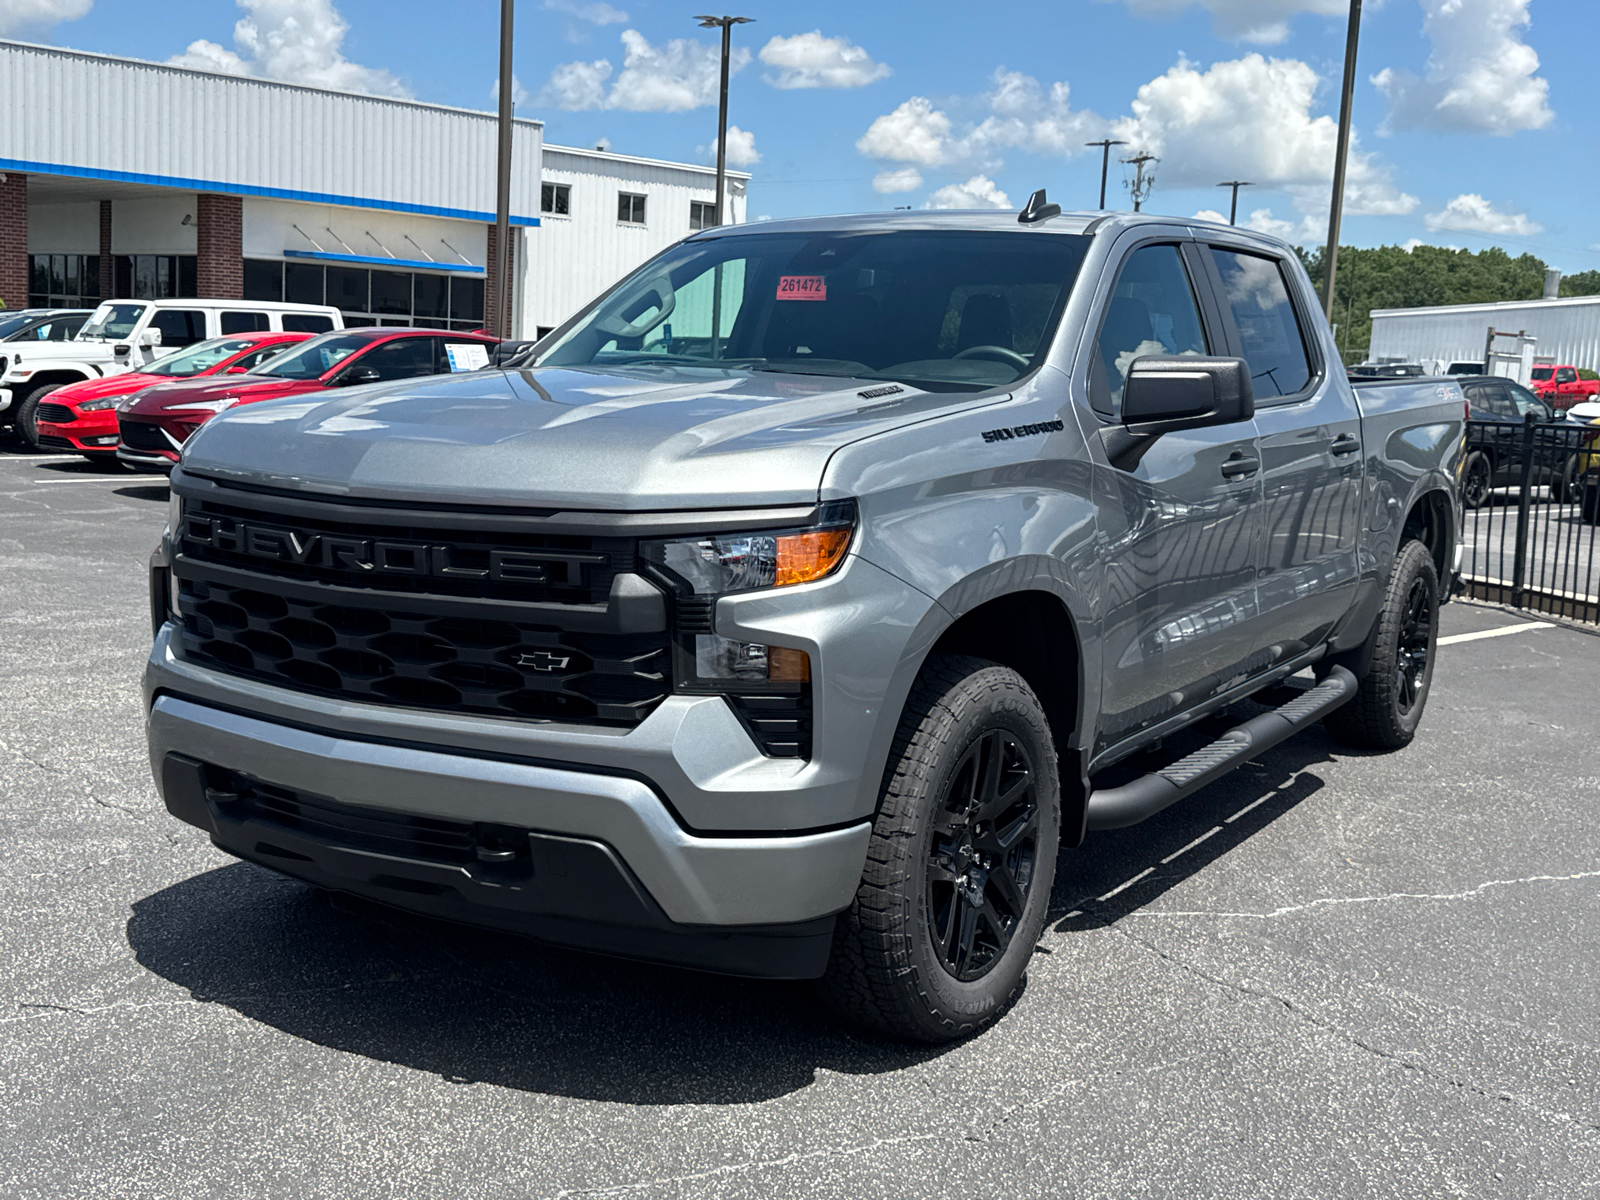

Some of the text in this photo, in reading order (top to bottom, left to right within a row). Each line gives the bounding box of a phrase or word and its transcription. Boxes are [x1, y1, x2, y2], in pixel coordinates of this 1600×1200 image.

[781, 278, 822, 292] 261472
[981, 419, 1064, 443] SILVERADO
[183, 512, 609, 587] CHEVROLET
